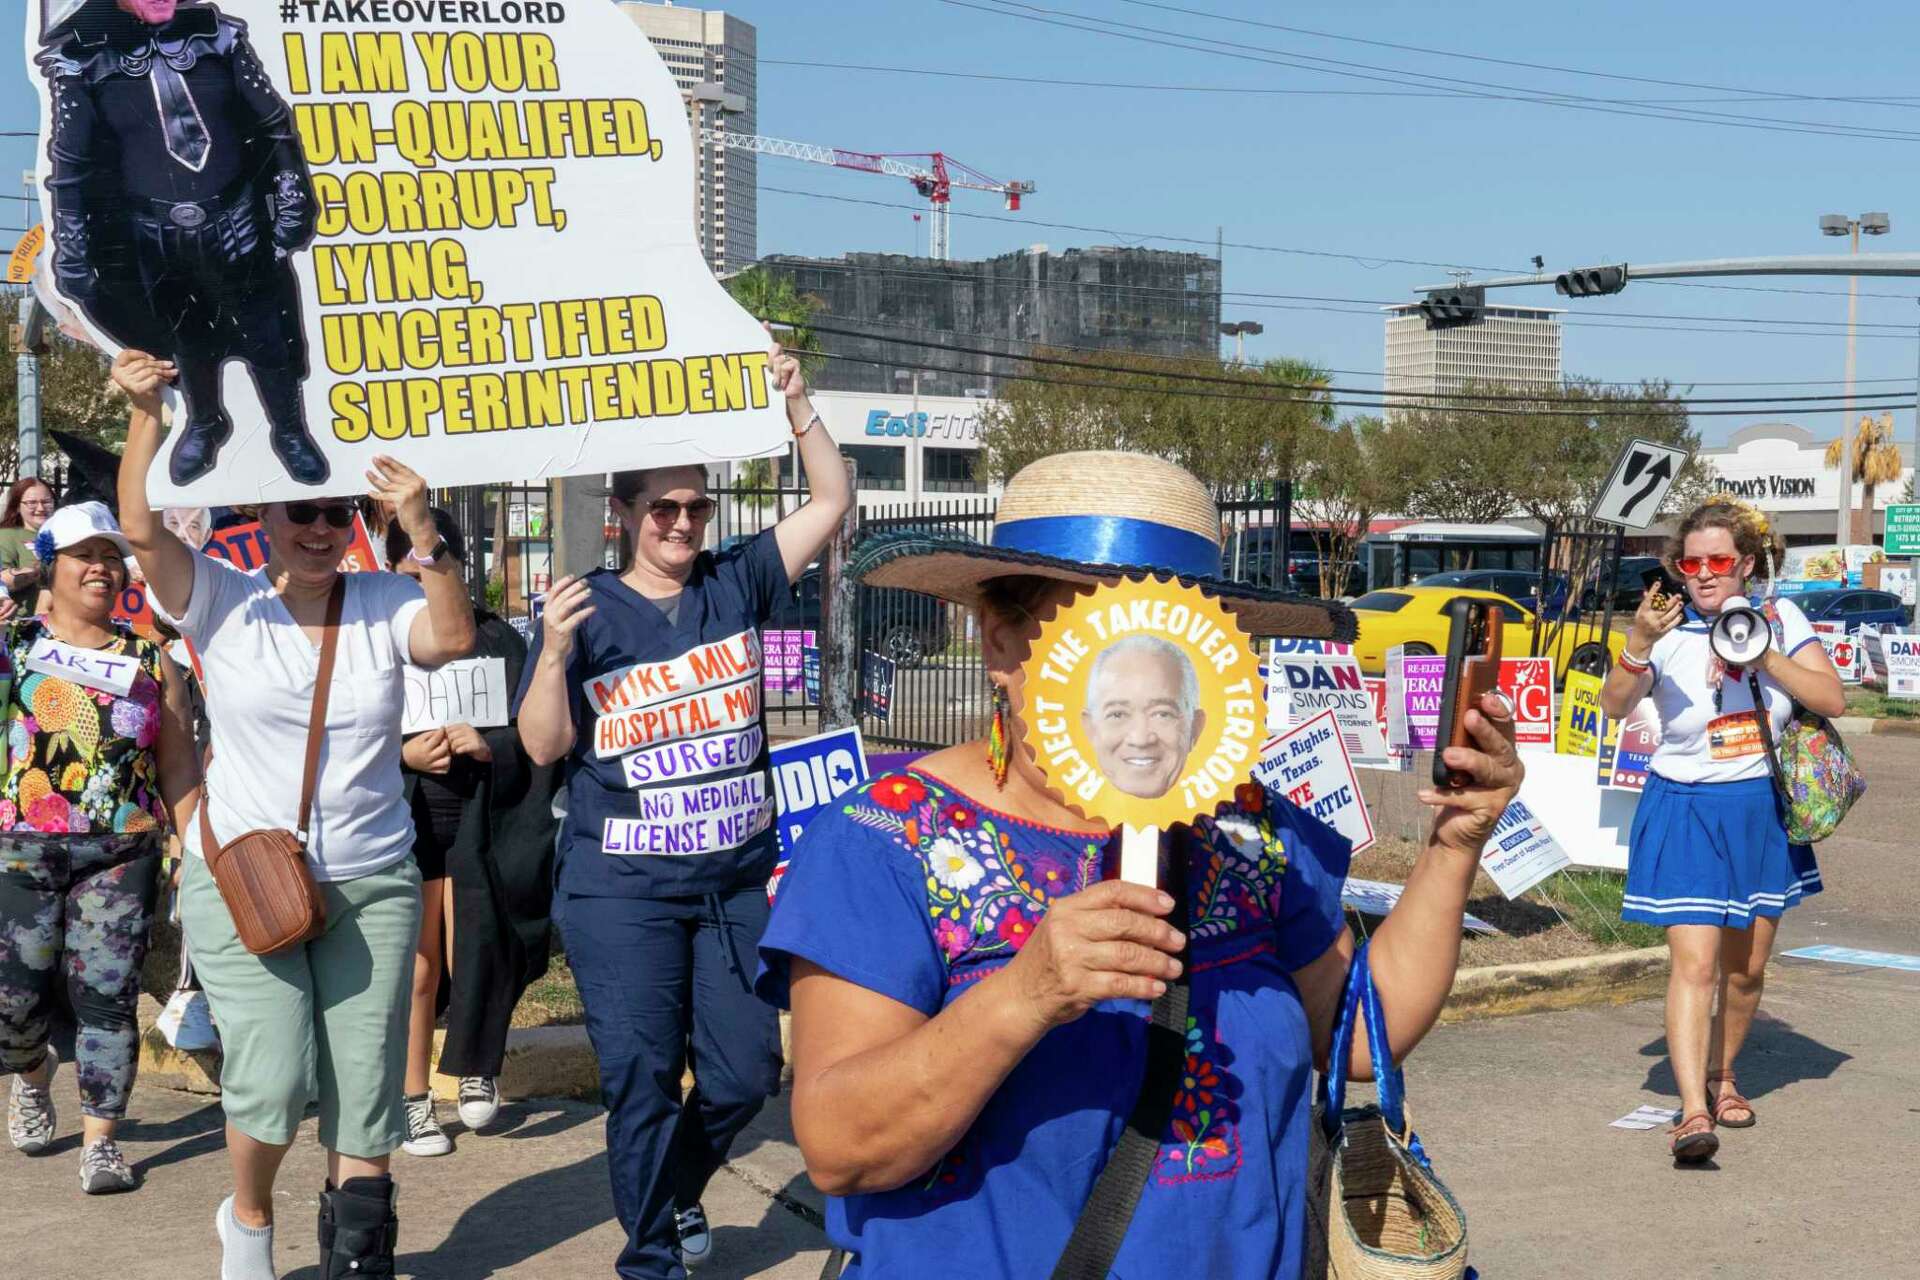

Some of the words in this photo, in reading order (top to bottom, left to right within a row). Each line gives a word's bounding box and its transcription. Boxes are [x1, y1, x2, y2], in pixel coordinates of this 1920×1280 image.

[280, 0, 565, 23] #TAKEOVERLORD
[283, 32, 311, 94] I
[321, 32, 409, 94] AM
[412, 31, 560, 93] YOUR
[293, 99, 663, 168] UN-QUALIFIED,
[311, 167, 567, 236] CORRUPT,
[312, 238, 484, 305] LYING,
[321, 295, 667, 375] UNCERTIFIED
[329, 351, 769, 443] SUPERINTENDENT
[1770, 474, 1815, 497] VISION
[1040, 629, 1089, 685] THE
[1086, 599, 1240, 674] TAKEOVER
[39, 649, 127, 679] ART
[593, 664, 681, 713] MIKE
[1284, 665, 1362, 690] DAN
[404, 665, 489, 727] DATA
[1293, 692, 1368, 709] SIMONS
[600, 697, 720, 751] HOSPITAL
[1036, 696, 1105, 802] REJECT
[1181, 678, 1255, 809] TERROR!
[1338, 719, 1373, 728] TTORNEY
[631, 728, 761, 781] SURGEON
[1258, 752, 1288, 775] Your
[1289, 727, 1335, 758] Rights.
[1281, 755, 1324, 783] Texas.
[1628, 753, 1650, 763] TEXA
[643, 792, 674, 821] NO
[682, 777, 762, 816] MEDICAL
[605, 820, 709, 854] LICENSE
